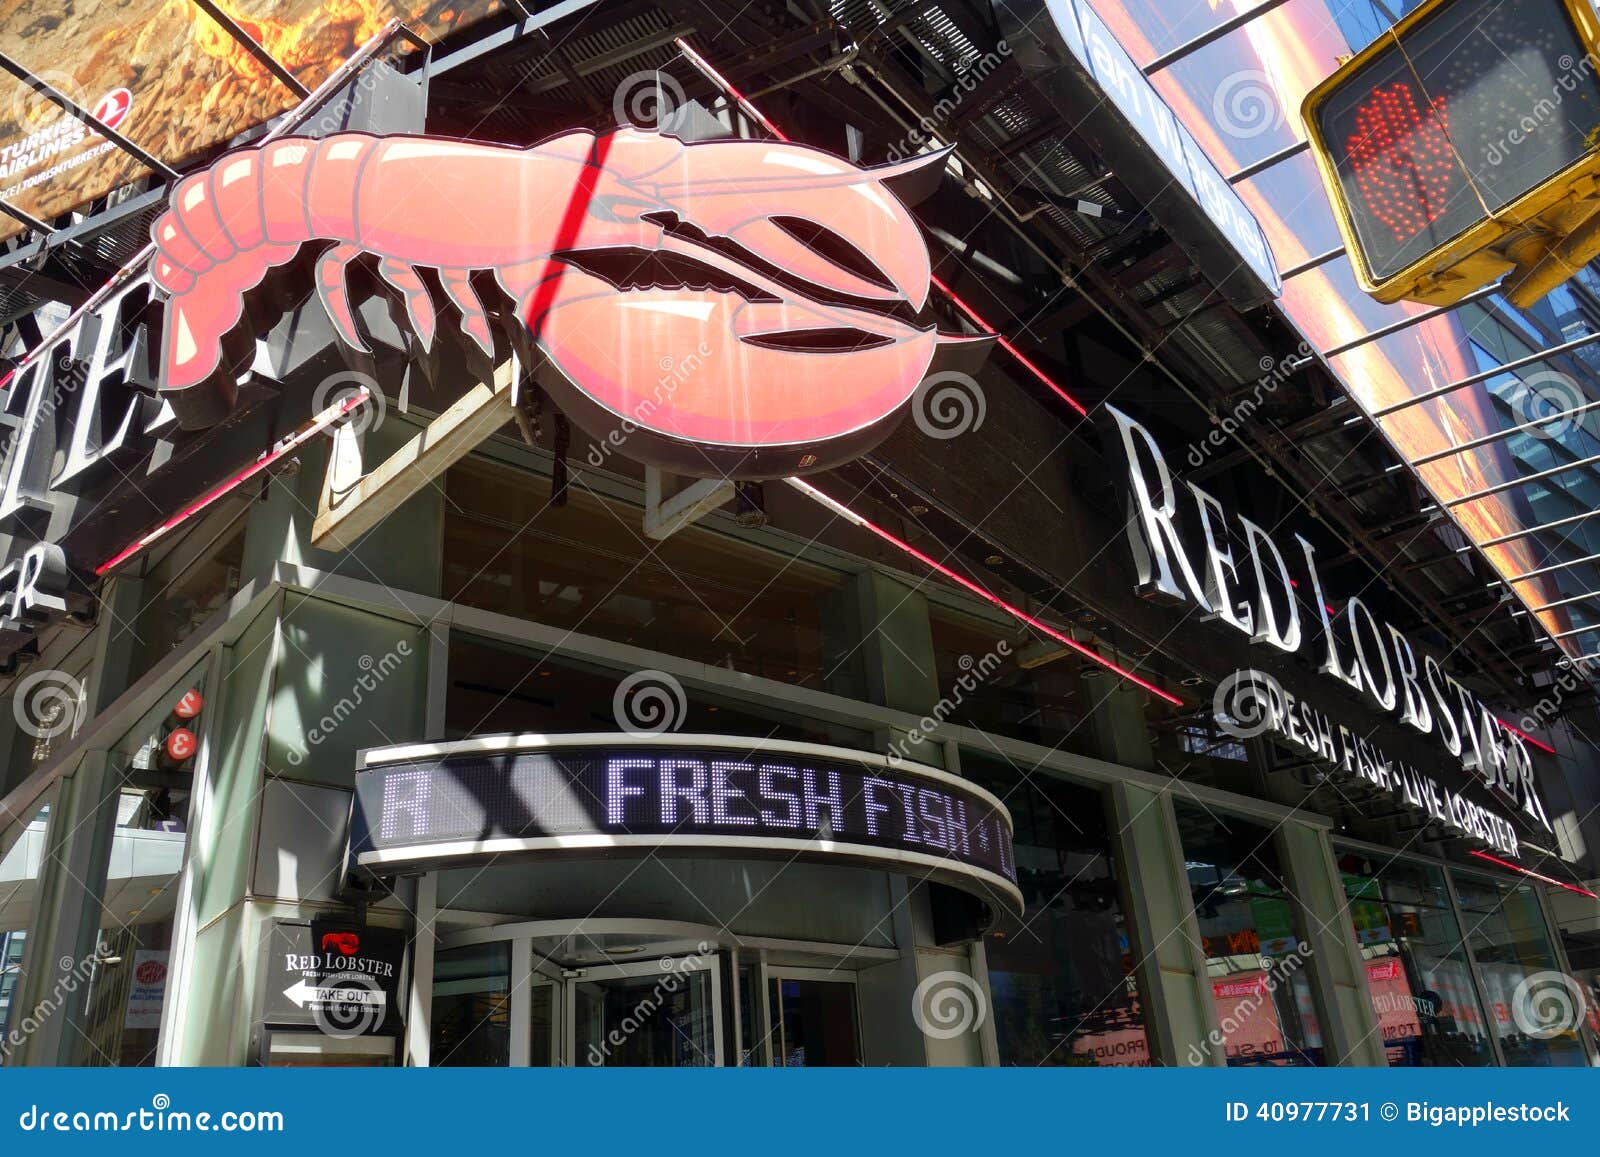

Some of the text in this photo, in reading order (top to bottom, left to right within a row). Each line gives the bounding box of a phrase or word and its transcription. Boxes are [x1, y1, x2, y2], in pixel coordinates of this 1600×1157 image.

[1144, 87, 1267, 275] Wagner
[1104, 402, 1554, 833] RED LOBSTER
[1250, 668, 1521, 859] FRESH FISH LIVE LOBSTER
[607, 758, 844, 833] FRESH
[863, 776, 970, 856] FISH
[285, 952, 393, 977] RED LOBSTER
[302, 970, 320, 978] FRESH
[314, 989, 370, 1002] TAKE OUT
[1391, 993, 1438, 1018] LOBSTER
